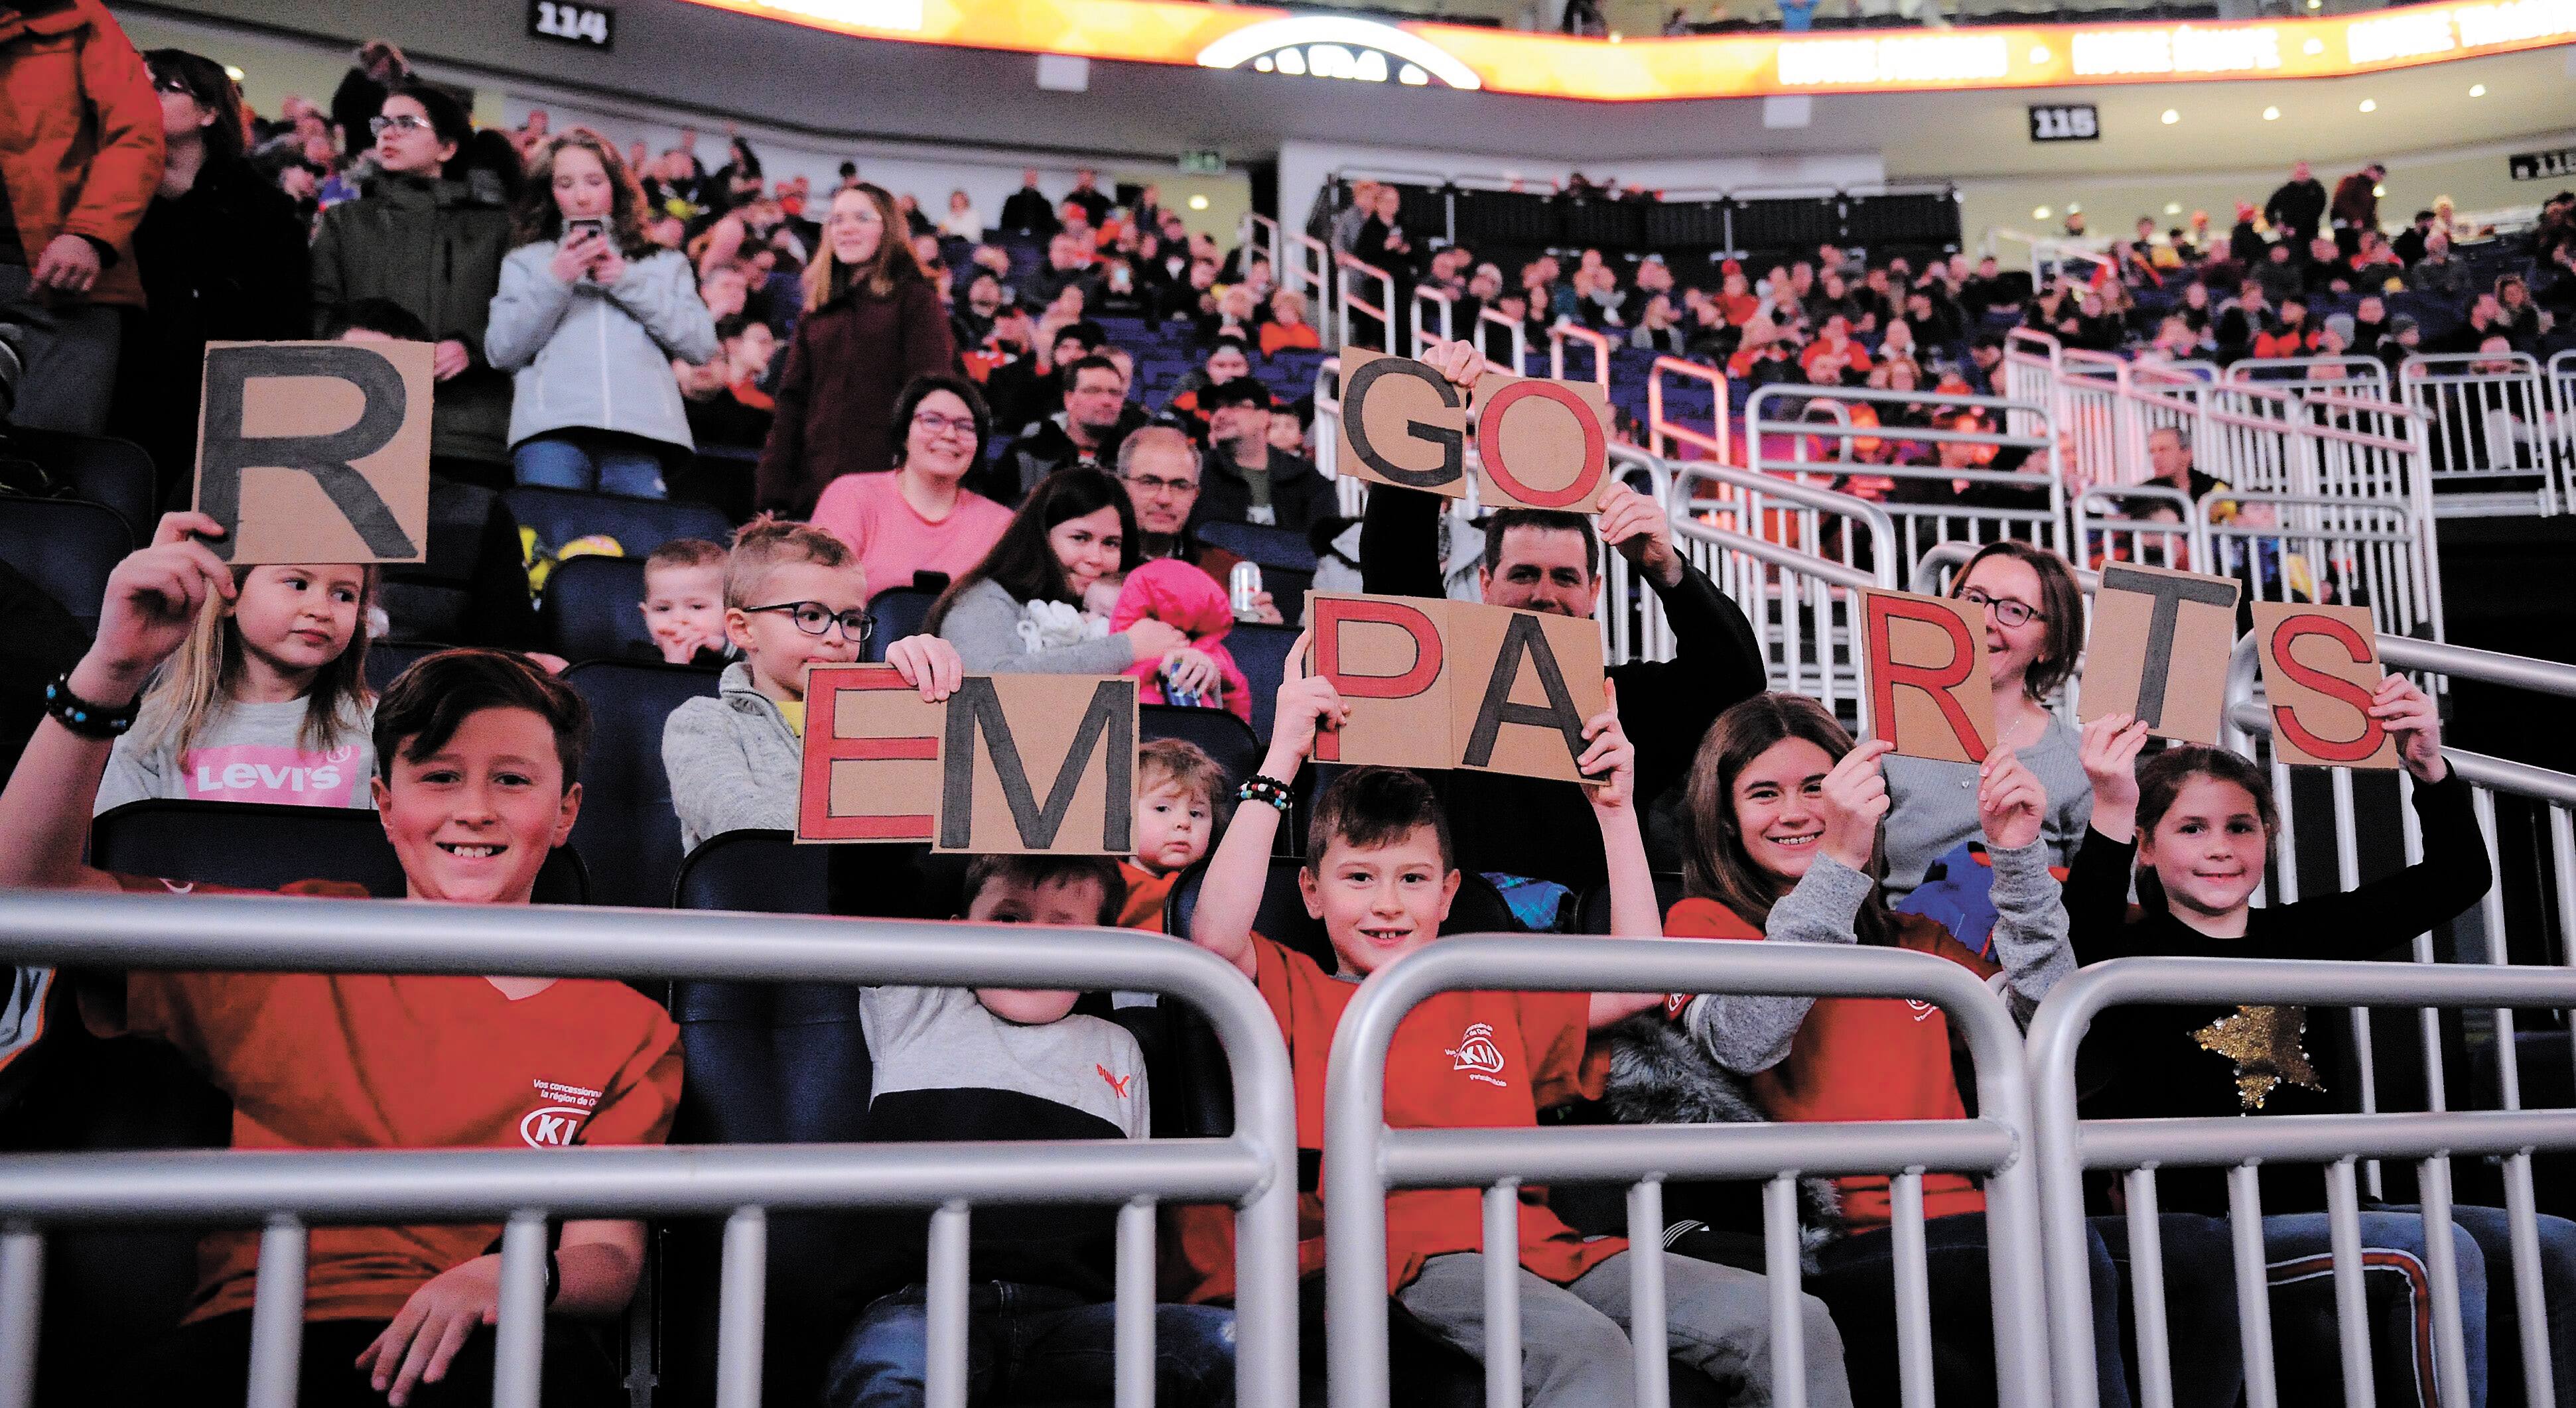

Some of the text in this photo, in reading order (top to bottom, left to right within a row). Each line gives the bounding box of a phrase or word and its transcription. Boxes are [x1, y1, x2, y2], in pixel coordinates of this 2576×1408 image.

[536, 2, 608, 44] 114
[2033, 108, 2096, 138] 115
[198, 346, 419, 562] R
[1460, 1044, 1497, 1067] KIA
[533, 1078, 549, 1088] Vos
[541, 1089, 549, 1098] la
[549, 1091, 576, 1103] région
[576, 1096, 588, 1106] de
